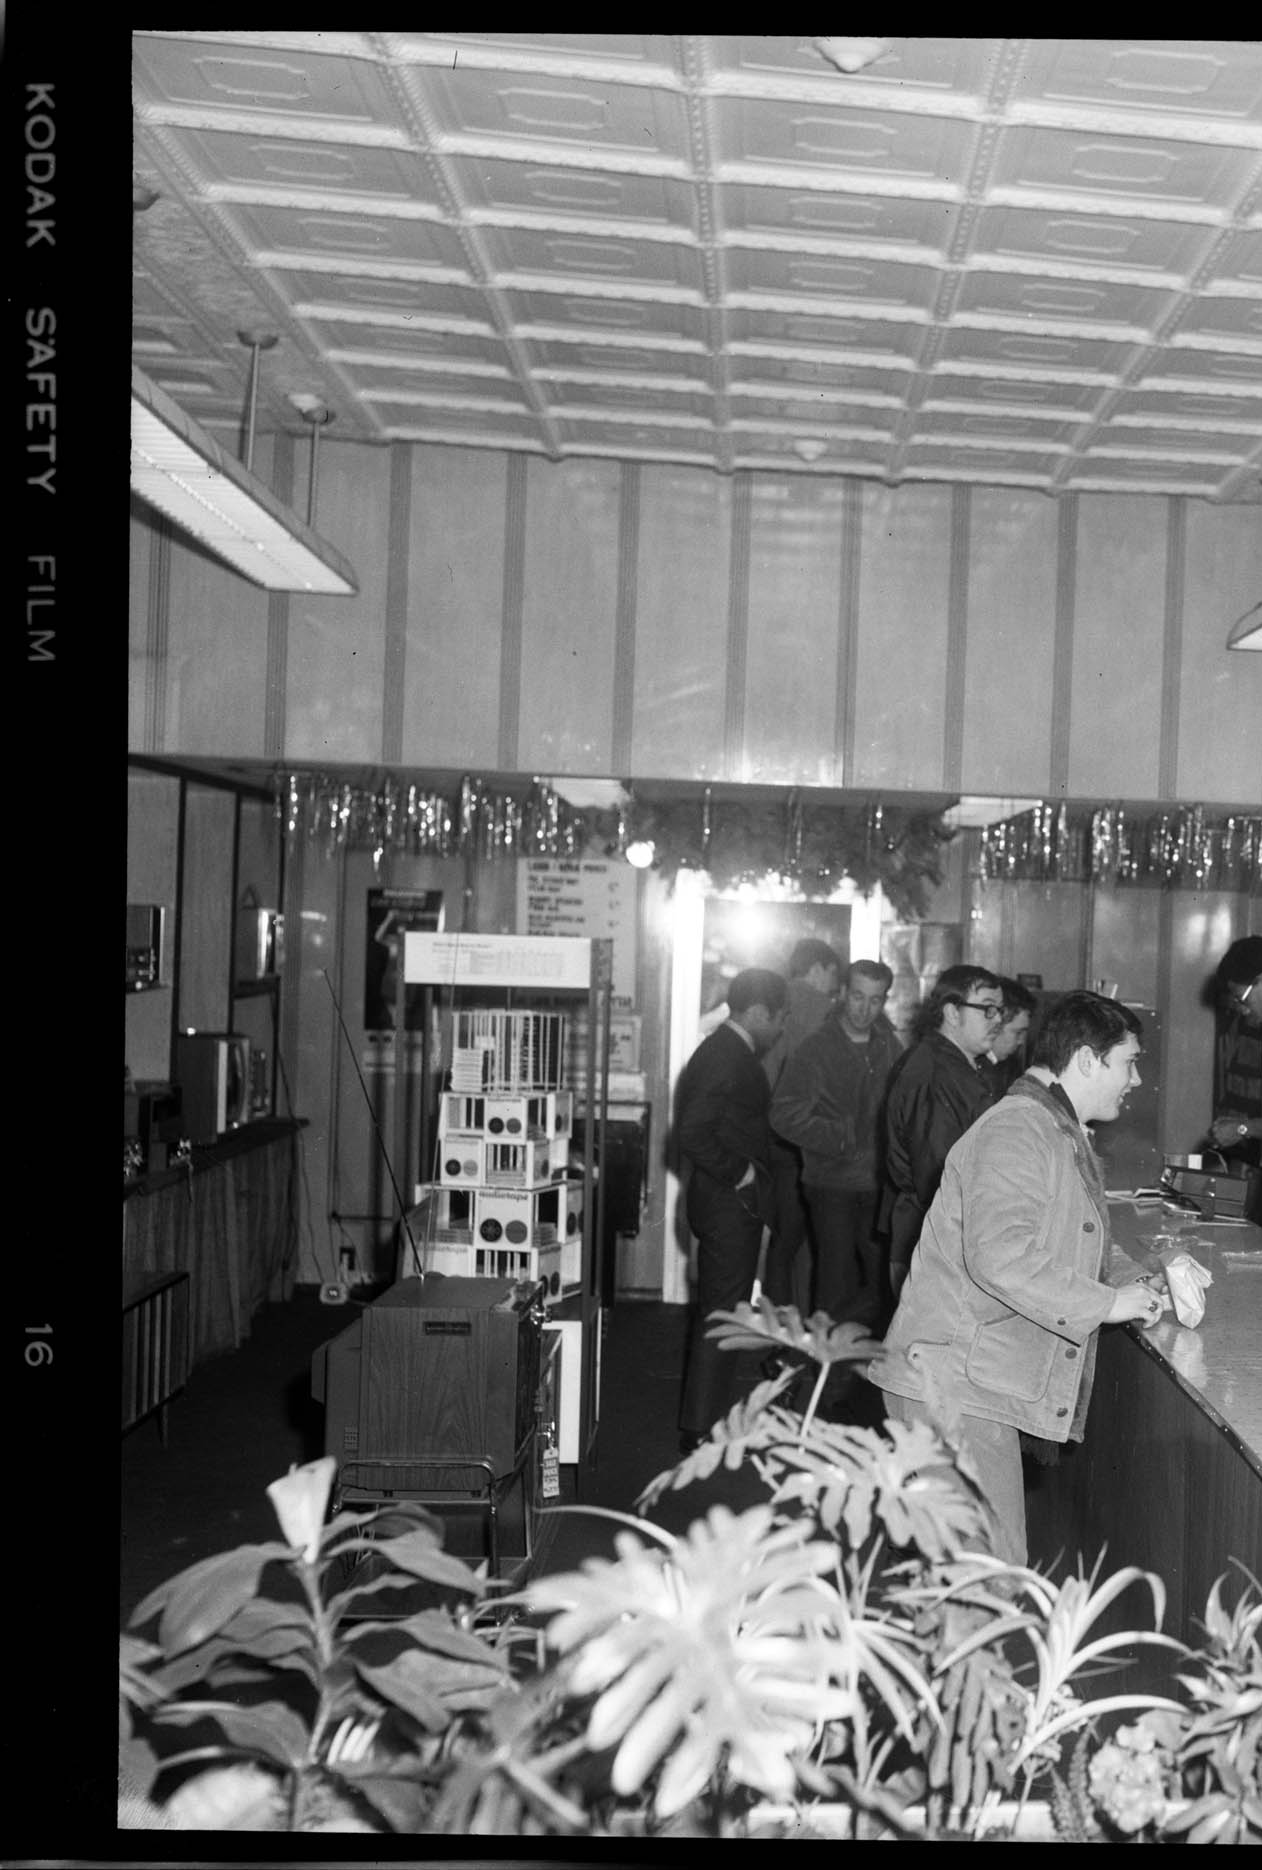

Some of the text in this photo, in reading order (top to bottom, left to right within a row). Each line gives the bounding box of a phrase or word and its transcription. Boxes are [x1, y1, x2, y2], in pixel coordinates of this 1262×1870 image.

[25, 83, 57, 661] KODAK SAFETY FILM
[24, 1323, 54, 1367] 16
